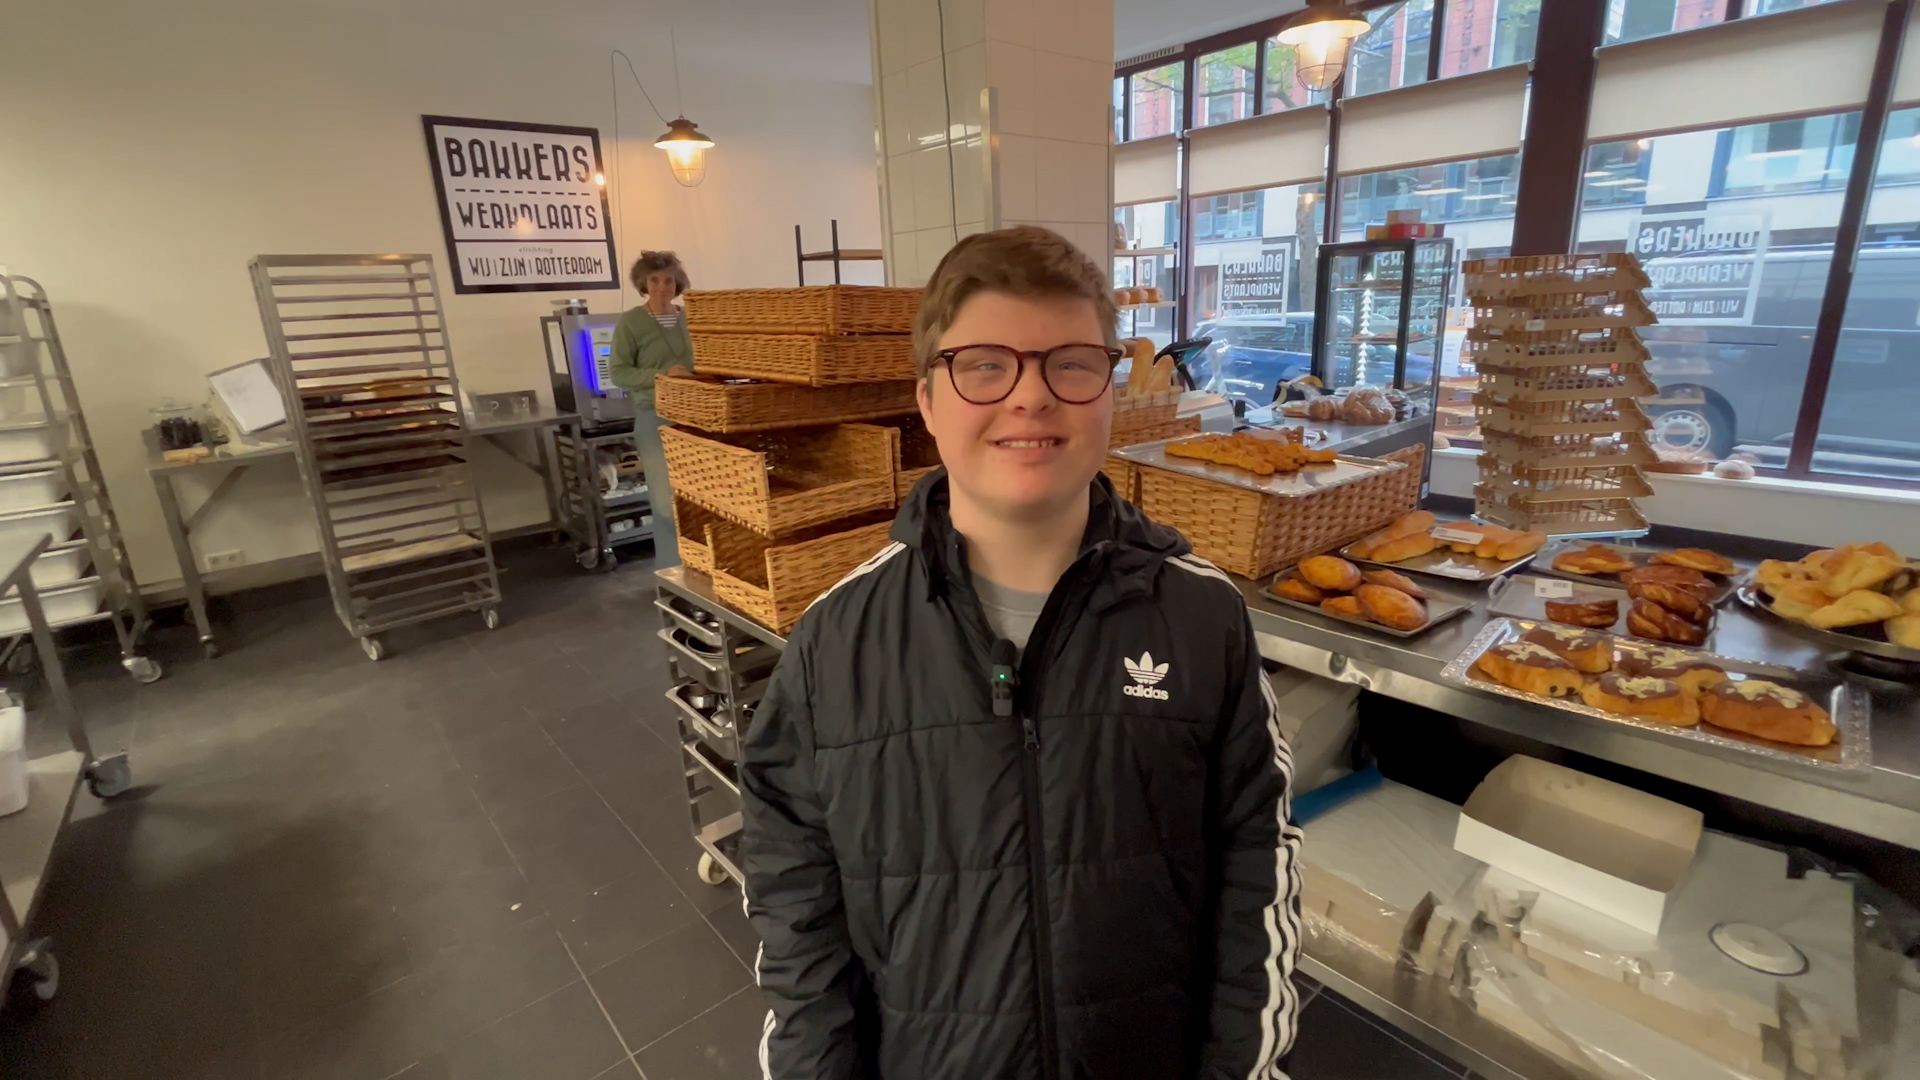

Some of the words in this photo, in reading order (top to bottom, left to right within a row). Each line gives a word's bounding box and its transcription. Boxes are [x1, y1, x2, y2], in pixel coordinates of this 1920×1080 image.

[444, 137, 591, 183] BAKKERS
[455, 201, 598, 230] WERKPLAATS
[468, 256, 491, 277] WIJ
[499, 257, 526, 277] ZIJN
[536, 256, 603, 276] ROTTERDAM
[1123, 684, 1169, 700] adidas
